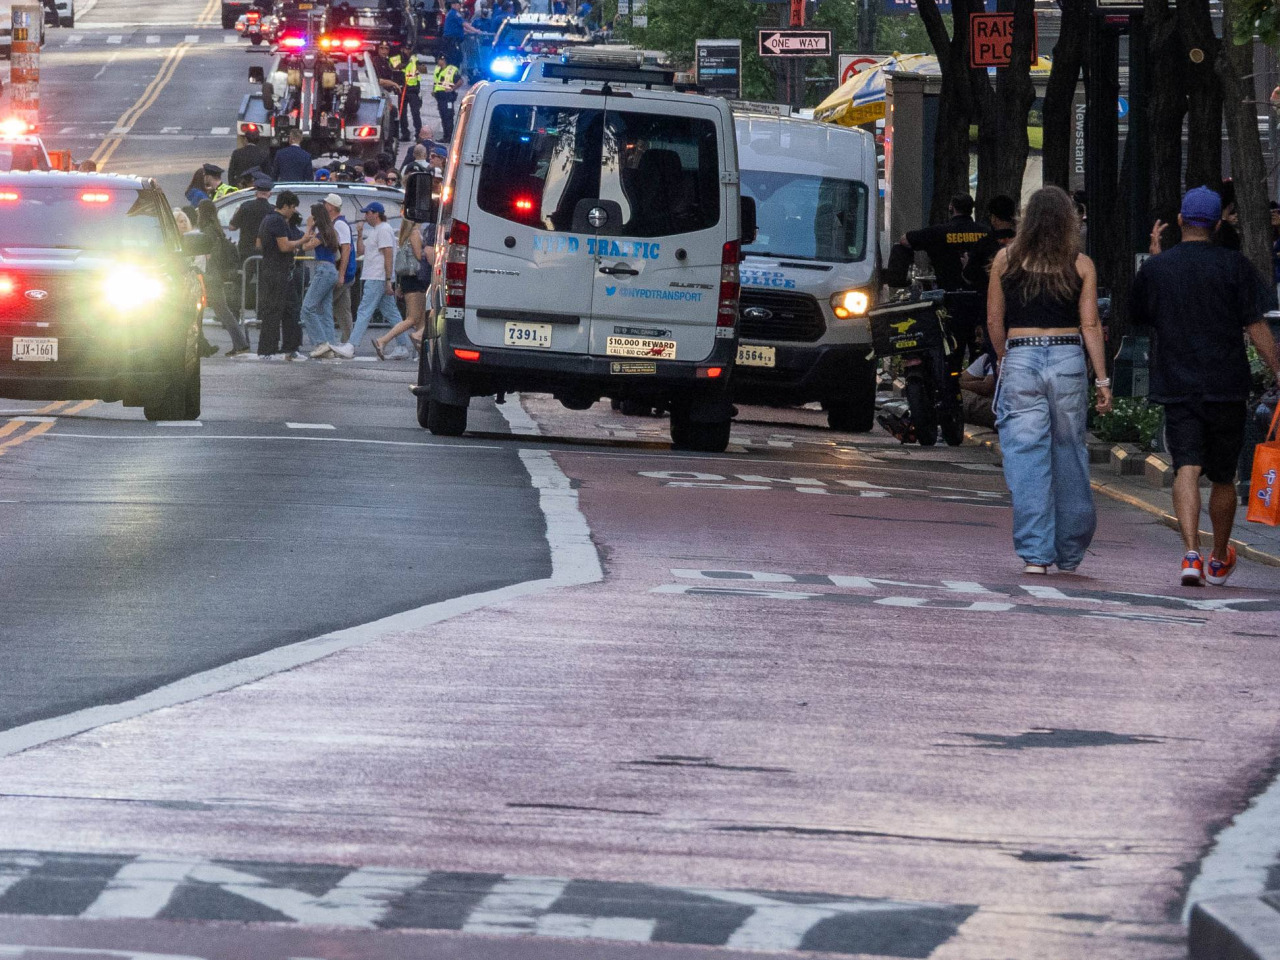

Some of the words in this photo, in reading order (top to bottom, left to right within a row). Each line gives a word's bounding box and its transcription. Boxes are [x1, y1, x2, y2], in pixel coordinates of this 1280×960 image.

[771, 39, 790, 48] ONE
[799, 38, 820, 48] WAY
[980, 42, 1013, 60] PLO
[1075, 104, 1086, 173] Newsstand
[532, 235, 580, 254] NYPD
[587, 237, 660, 260] TRAFFIC
[740, 269, 785, 278] NYPD
[740, 275, 796, 289] OLICE
[619, 286, 702, 302] @NYPDTRANSPORT
[508, 328, 538, 342] 7391
[609, 338, 640, 347] $10,000
[641, 340, 675, 350] REWARD
